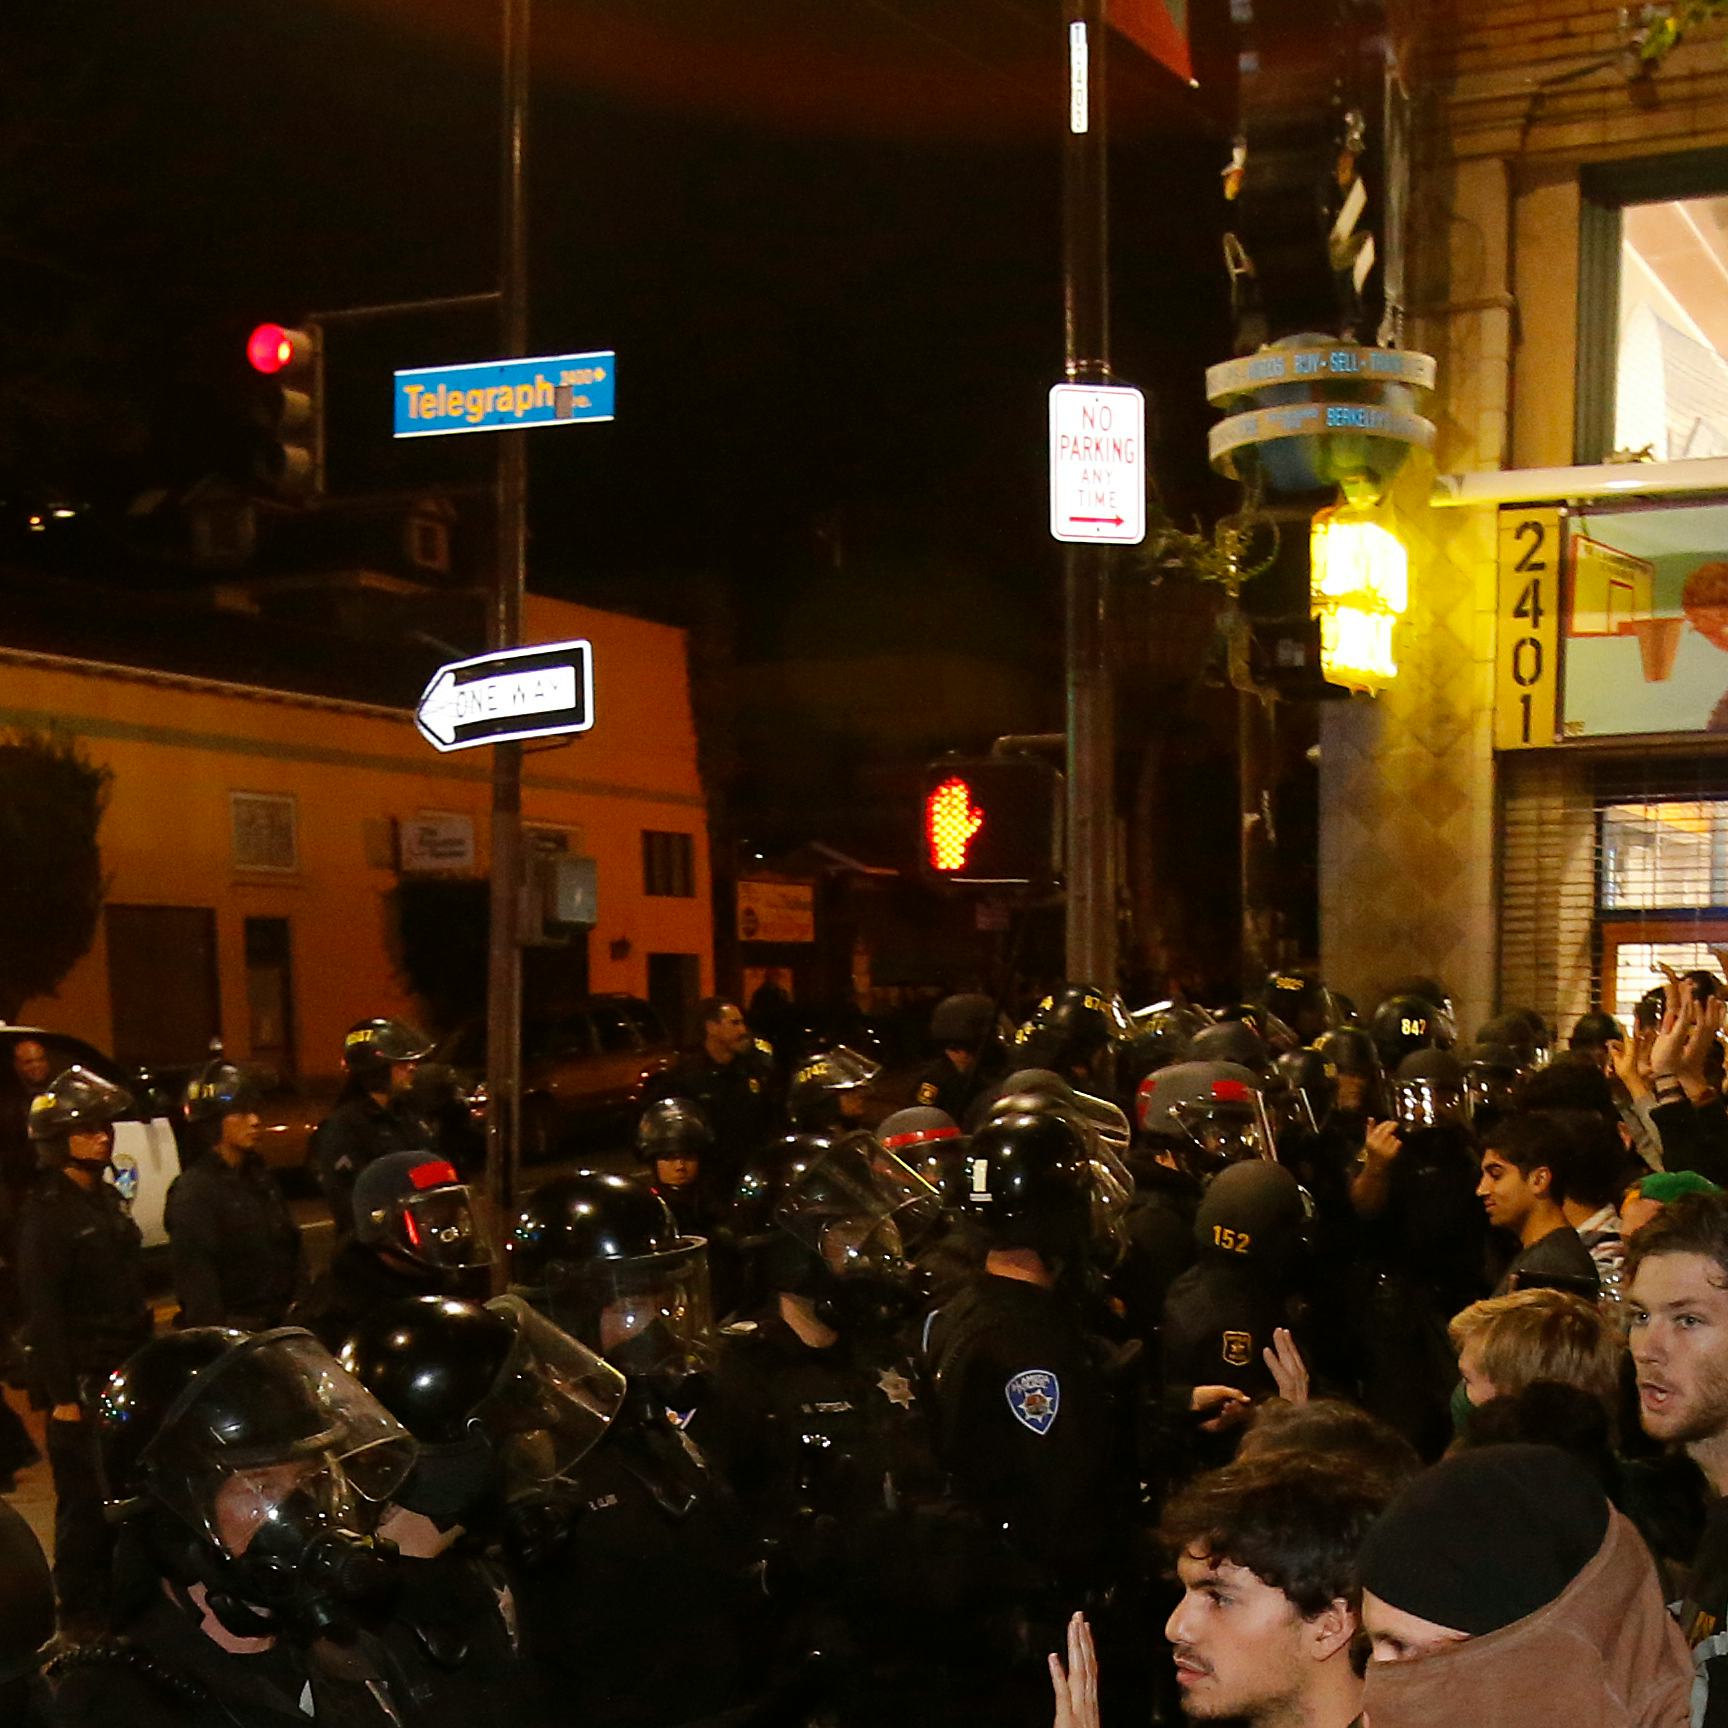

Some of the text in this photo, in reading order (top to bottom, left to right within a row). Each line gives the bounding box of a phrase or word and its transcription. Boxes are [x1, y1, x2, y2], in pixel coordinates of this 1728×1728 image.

[403, 374, 555, 423] Telegraph
[1083, 405, 1112, 431] NO
[1060, 434, 1134, 464] PARKING
[1082, 469, 1112, 485] ANY
[1078, 489, 1117, 509] TIME
[1512, 520, 1546, 743] 2401
[457, 679, 559, 718] ONE WAY
[1213, 1225, 1250, 1254] 152
